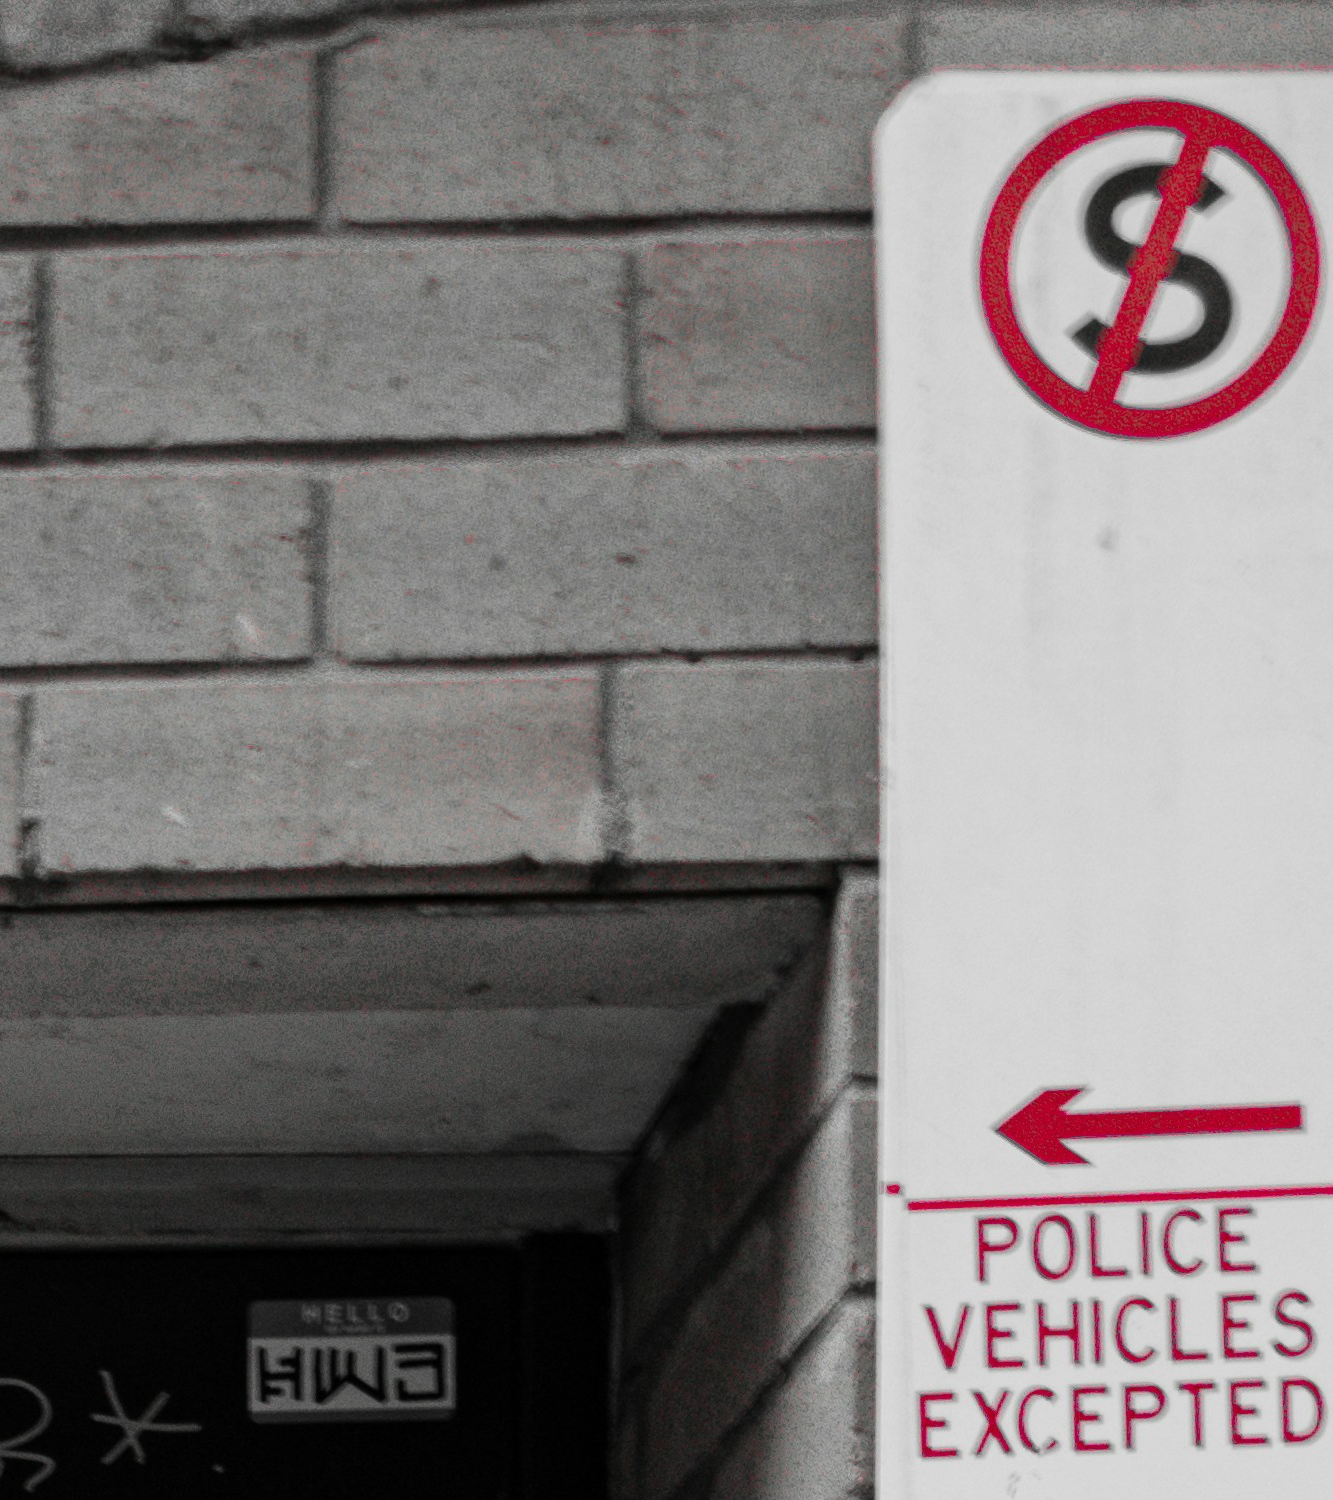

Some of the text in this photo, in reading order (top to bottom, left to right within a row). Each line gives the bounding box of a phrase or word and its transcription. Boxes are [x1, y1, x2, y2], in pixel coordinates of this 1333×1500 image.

[975, 1206, 1259, 1284] POLICE
[300, 1301, 412, 1325] HELLO
[923, 1290, 1316, 1370] VEHICLES
[917, 1377, 1325, 1459] EXCEPTED
